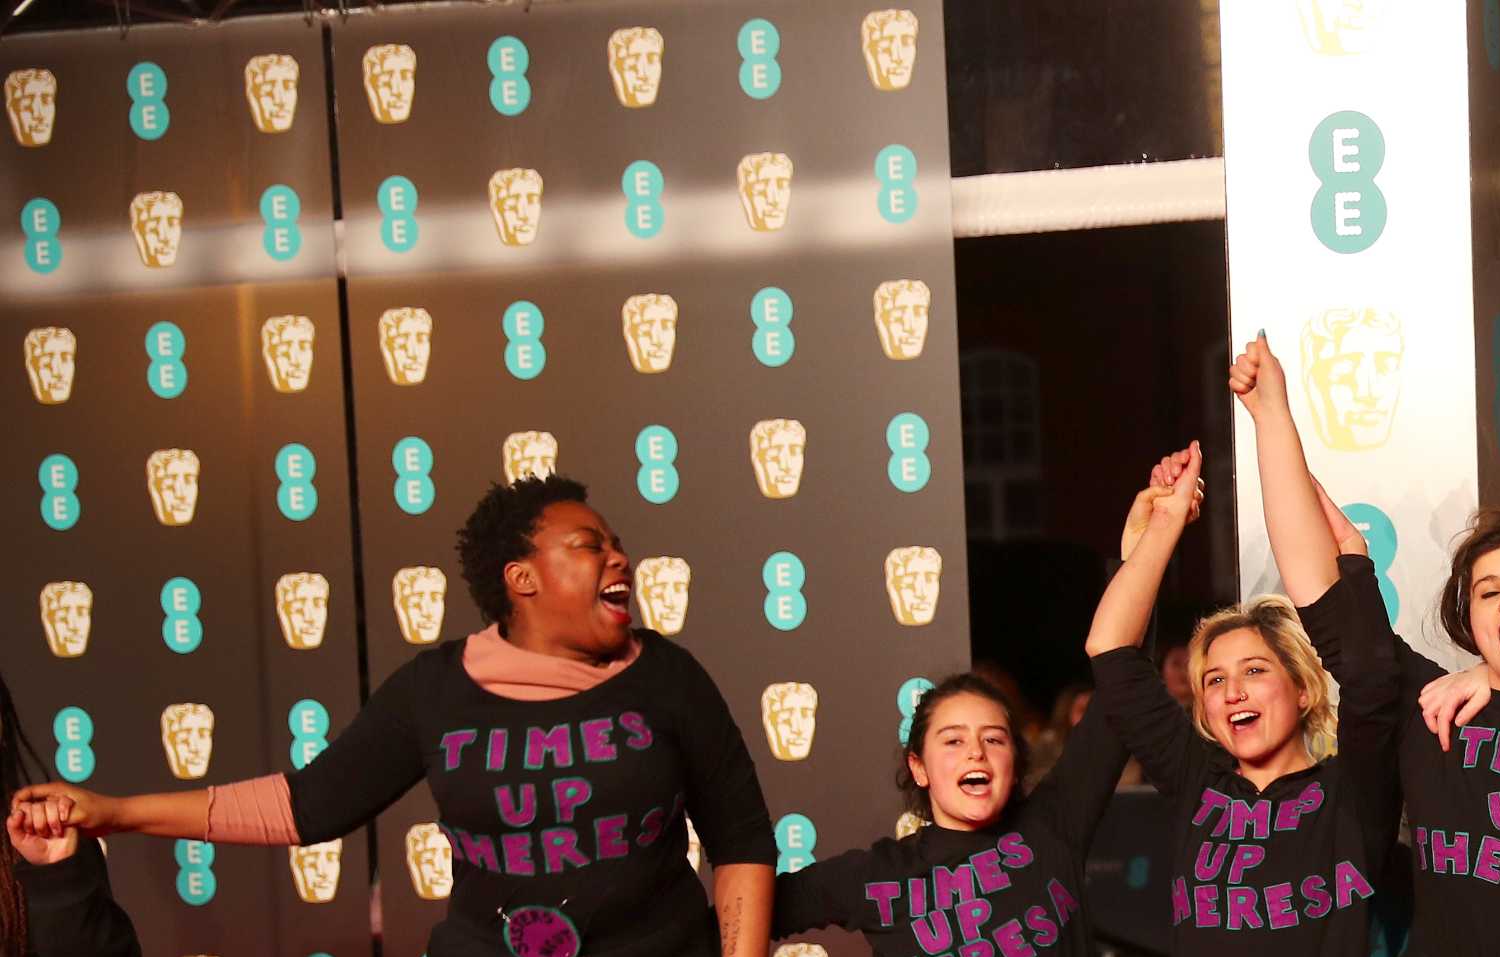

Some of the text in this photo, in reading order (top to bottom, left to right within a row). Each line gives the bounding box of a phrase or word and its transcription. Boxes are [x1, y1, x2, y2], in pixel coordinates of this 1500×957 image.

[500, 47, 517, 105] EE
[751, 29, 767, 89] EE
[140, 73, 155, 128] EE
[635, 172, 651, 229] EE
[888, 155, 905, 214] EE
[1332, 128, 1363, 236] EE
[33, 208, 50, 264] EE
[272, 195, 288, 253] EE
[390, 186, 406, 244] EE
[516, 312, 531, 368] EE
[764, 297, 780, 356] EE
[158, 332, 173, 388] EE
[288, 454, 303, 510] EE
[405, 447, 420, 504] EE
[649, 435, 664, 493] EE
[900, 424, 916, 482] EE
[50, 465, 68, 520] EE
[174, 588, 188, 643] EE
[776, 563, 792, 619] EE
[67, 717, 81, 772] EE
[440, 712, 653, 771] TIMES
[494, 777, 593, 827] UP
[1192, 781, 1325, 840] TIMES
[865, 832, 1034, 927] TIMES
[1194, 842, 1265, 884] UP
[1171, 860, 1375, 930] HERESA
[911, 898, 992, 956] UP
